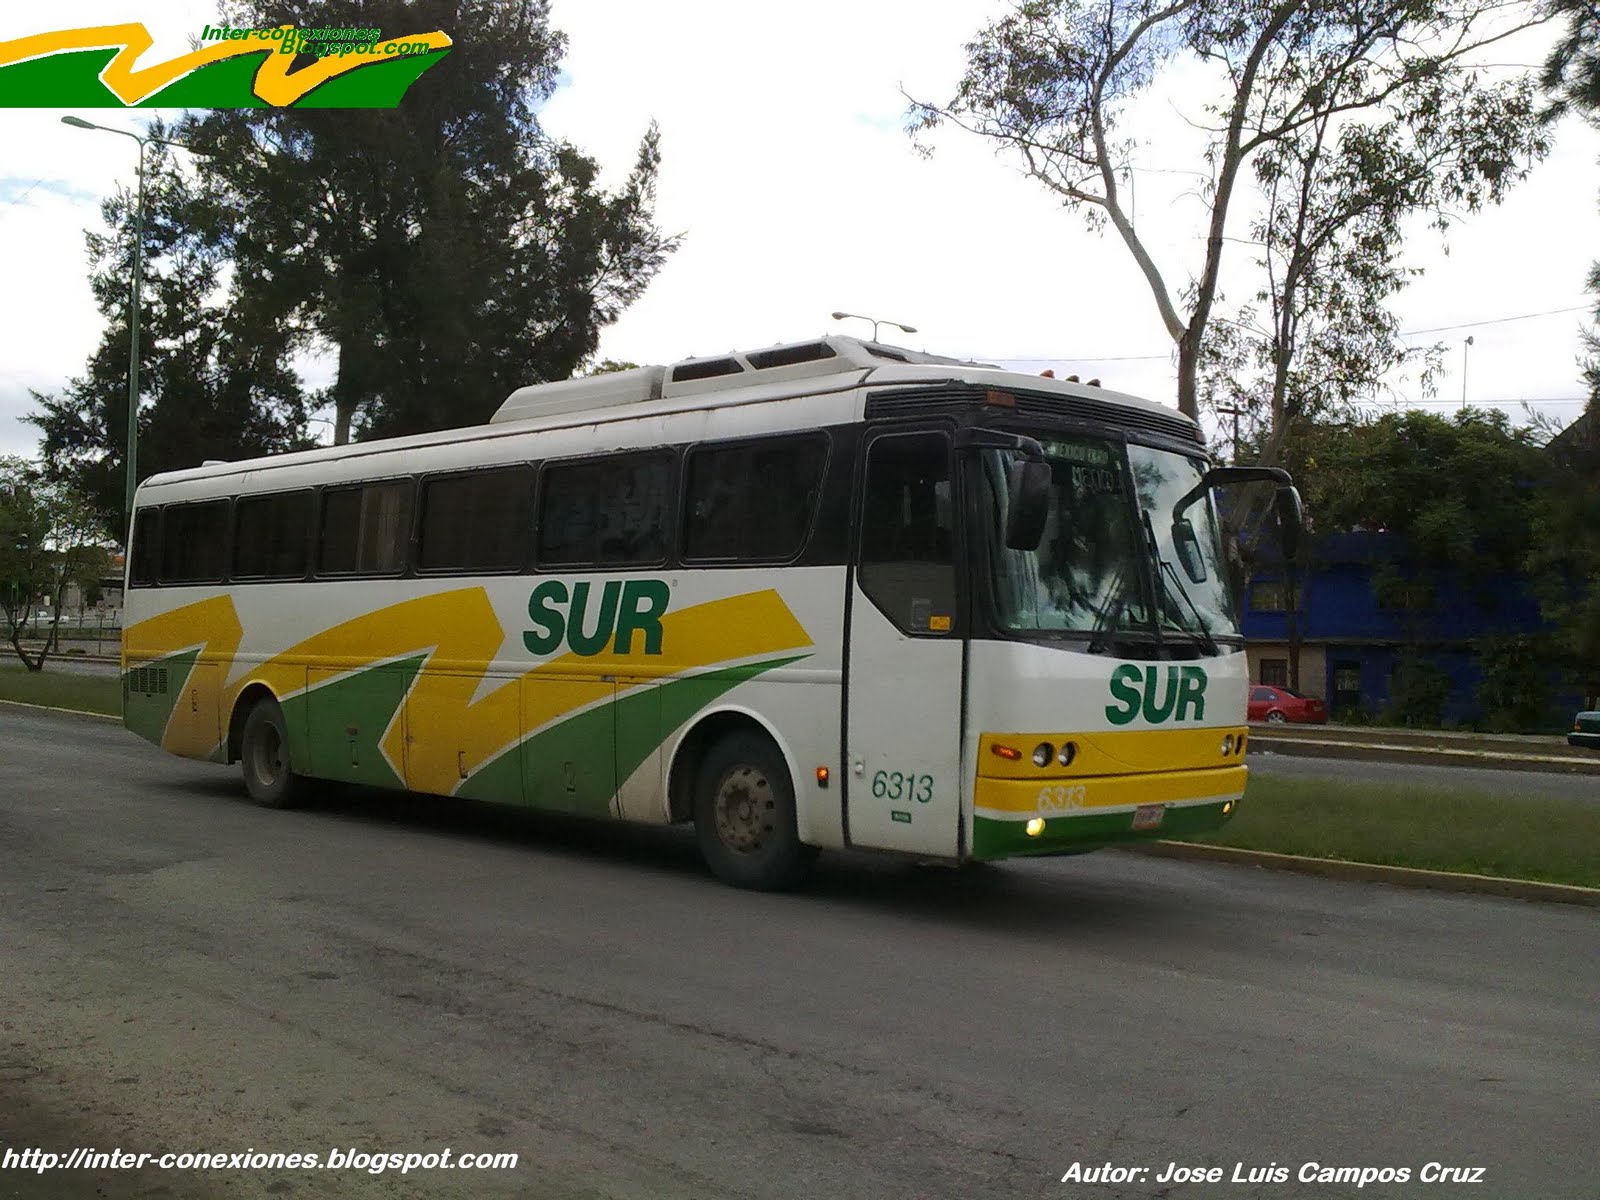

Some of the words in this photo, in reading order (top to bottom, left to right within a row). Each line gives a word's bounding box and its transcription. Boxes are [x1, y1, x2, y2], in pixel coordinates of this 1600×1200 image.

[523, 579, 671, 656] SUR
[1105, 663, 1208, 726] SUR
[872, 770, 934, 803] 6313
[1036, 785, 1086, 814] 6313
